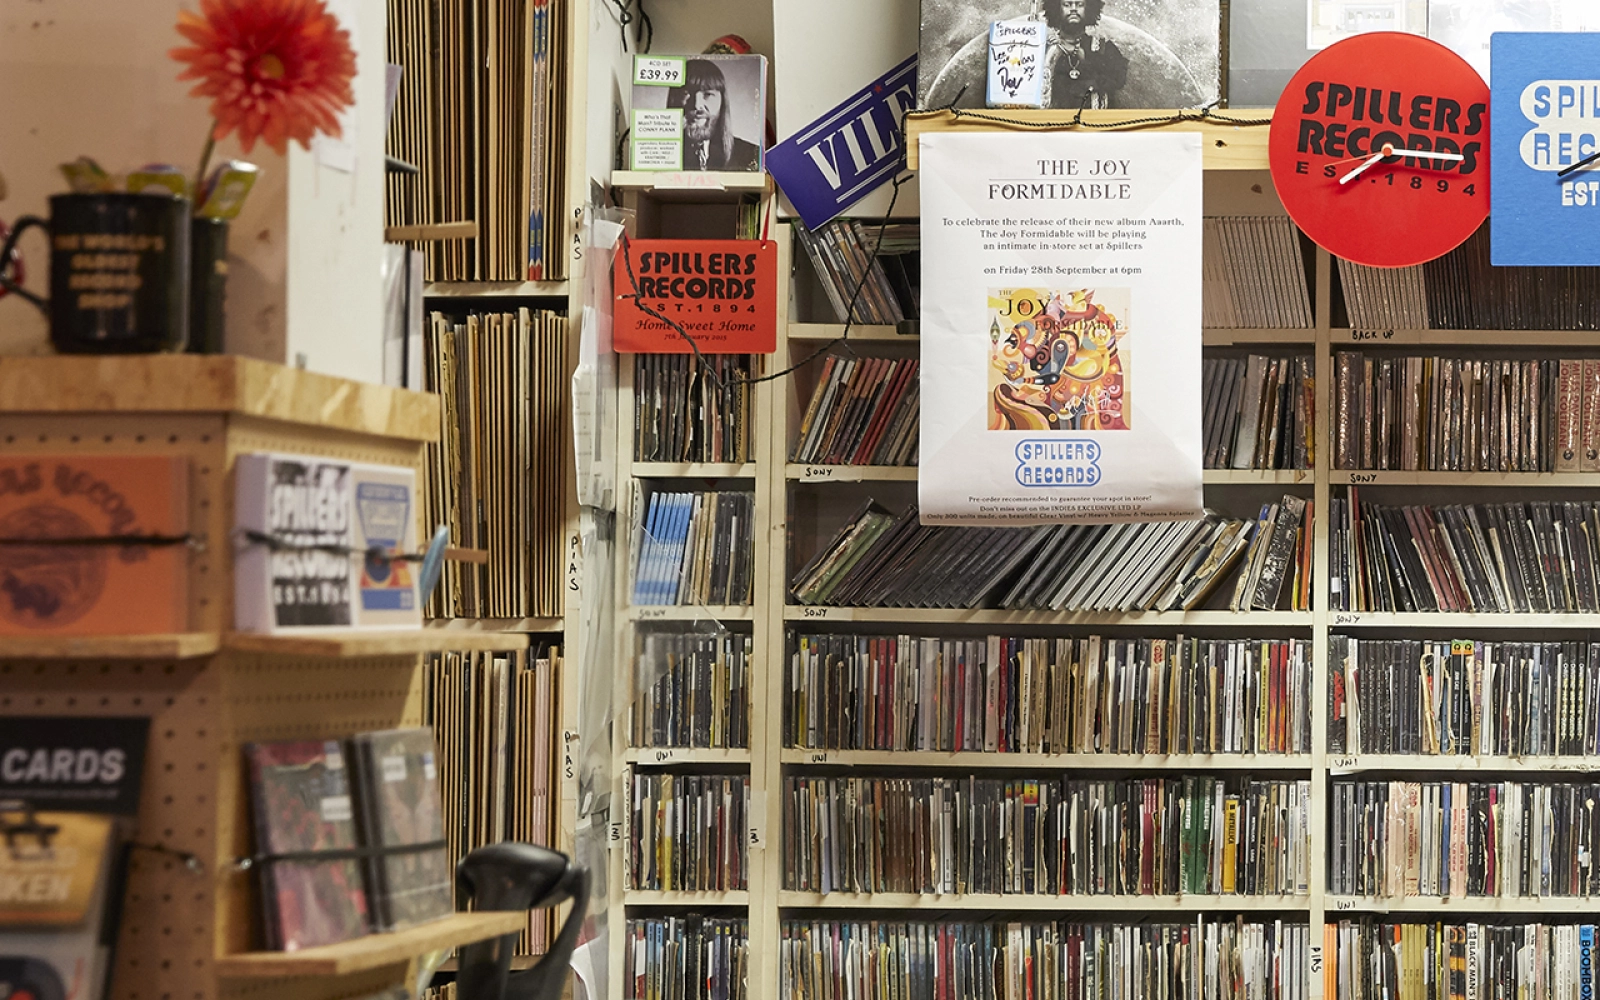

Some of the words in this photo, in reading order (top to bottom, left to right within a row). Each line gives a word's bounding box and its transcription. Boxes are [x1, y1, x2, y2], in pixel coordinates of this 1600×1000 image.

[639, 68, 679, 81] £39.99
[1302, 80, 1486, 136] SPILLERS
[1297, 118, 1482, 175] RECORDS
[1037, 159, 1080, 177] THE
[1089, 159, 1132, 177] JOY
[988, 183, 1132, 200] FORMIDABLE
[1561, 181, 1598, 207] EST
[942, 217, 954, 227] To
[955, 217, 1000, 227] celebrate
[1002, 217, 1018, 227] the
[1020, 217, 1054, 227] release
[1056, 217, 1068, 227] of
[1068, 217, 1092, 227] their
[1094, 217, 1114, 227] new
[1116, 217, 1146, 227] album
[1148, 217, 1185, 227] Aaarth,
[980, 230, 998, 240] The
[1000, 230, 1018, 240] Joy
[1020, 230, 1075, 240] Formidable
[1077, 230, 1096, 240] will
[1098, 230, 1110, 240] be
[1111, 230, 1147, 240] playing
[983, 242, 995, 251] an
[997, 242, 1037, 251] intimate
[1039, 242, 1077, 251] in-store
[1079, 242, 1093, 251] set
[1095, 242, 1104, 251] at
[1106, 242, 1143, 251] Spillers
[639, 252, 757, 275] SPILLERS
[983, 265, 996, 276] on
[999, 265, 1028, 276] Friday
[1030, 265, 1053, 276] 28th
[1055, 265, 1107, 276] September
[1109, 265, 1119, 276] at
[1120, 265, 1142, 276] 6pm
[639, 276, 756, 300] RECORDS
[999, 298, 1051, 317] JOY
[635, 319, 672, 331] Home
[678, 320, 714, 331] Sweet
[718, 319, 756, 332] Home
[1034, 319, 1123, 331] FORMIDABLE
[678, 334, 710, 342] Jauary
[1023, 443, 1095, 461] SPILLERS
[1023, 466, 1095, 484] RECORDS
[2, 748, 126, 783] CARDS
[1468, 940, 1476, 966] BLACK
[1582, 940, 1592, 1000] BOOMBOX
